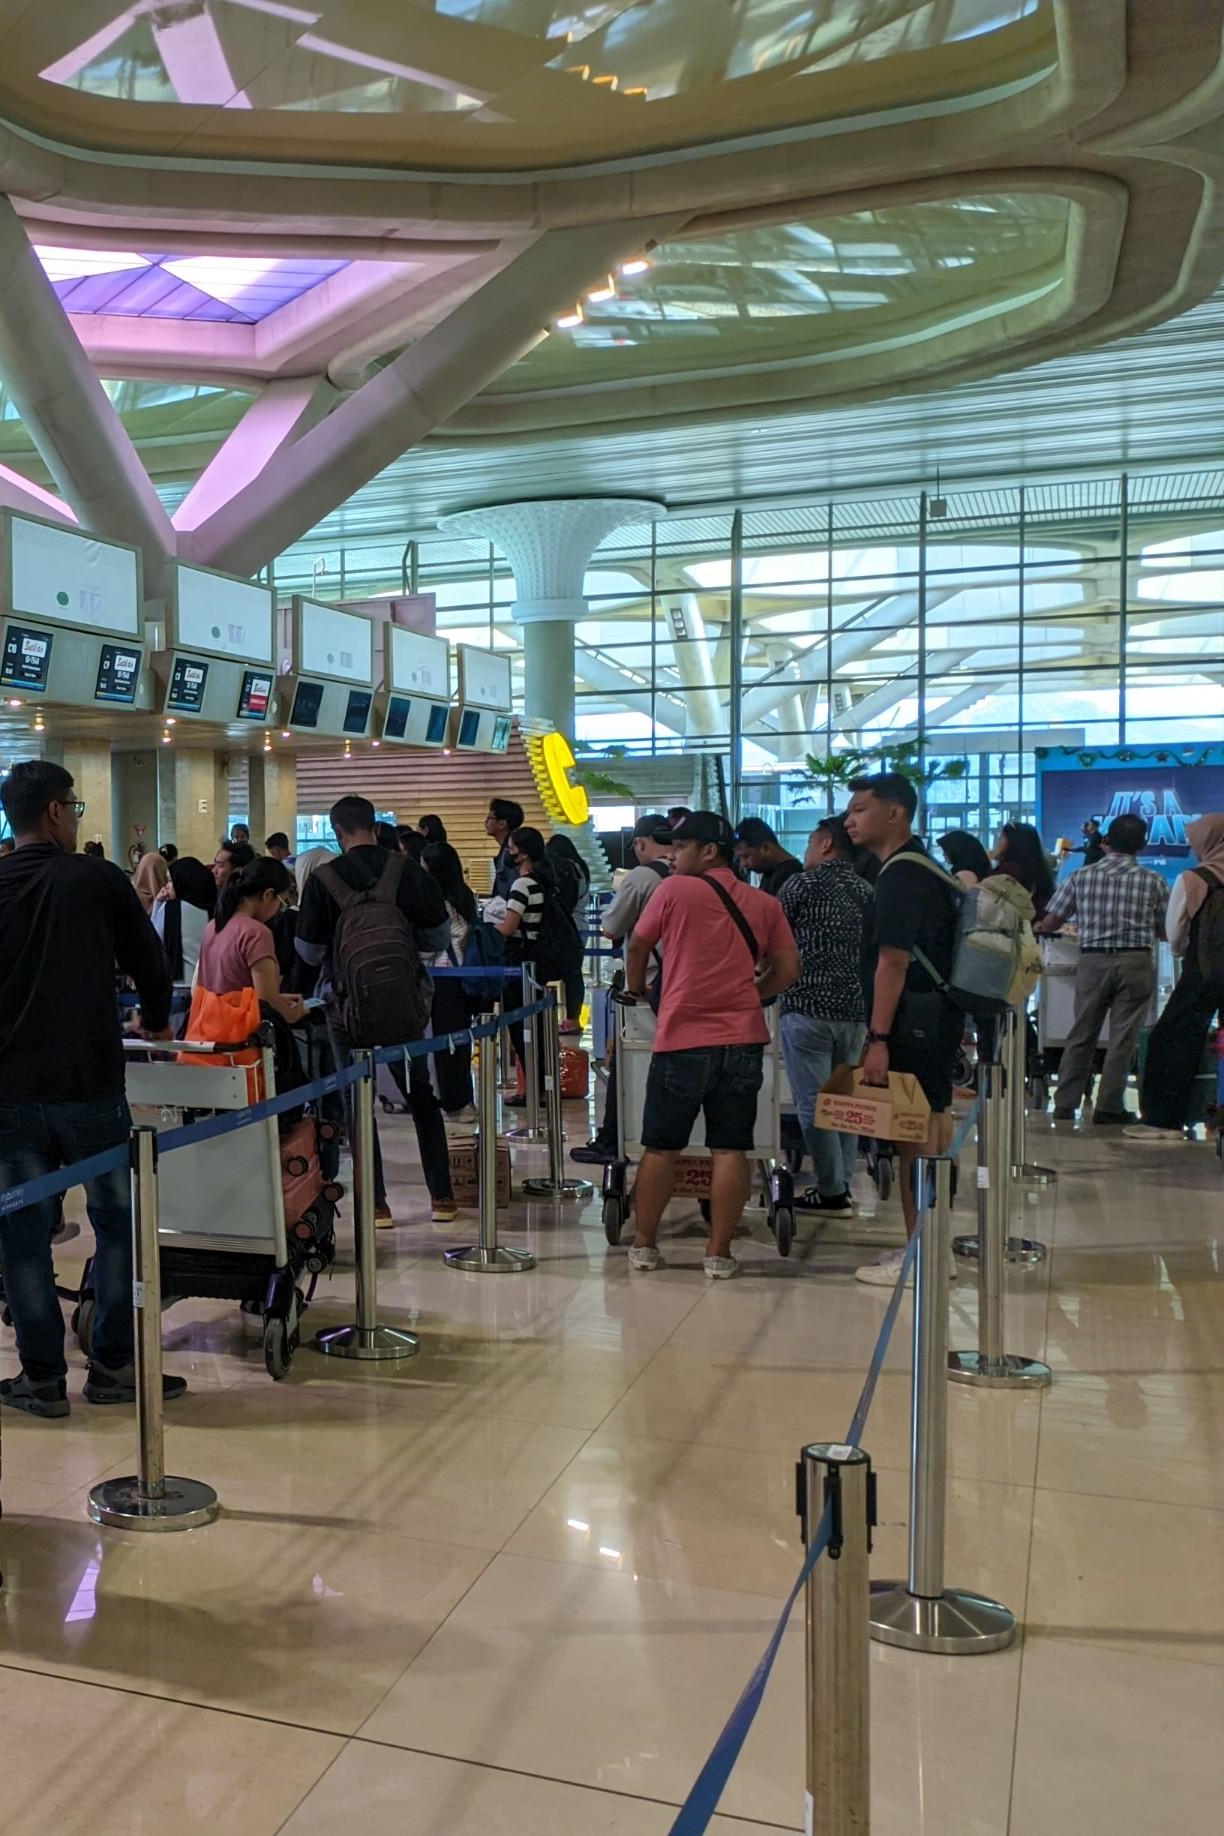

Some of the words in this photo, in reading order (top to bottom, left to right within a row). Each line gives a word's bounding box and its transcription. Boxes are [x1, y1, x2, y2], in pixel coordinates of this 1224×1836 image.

[1109, 790, 1157, 817] IT'S
[1163, 789, 1184, 816] A
[846, 1110, 863, 1125] 25
